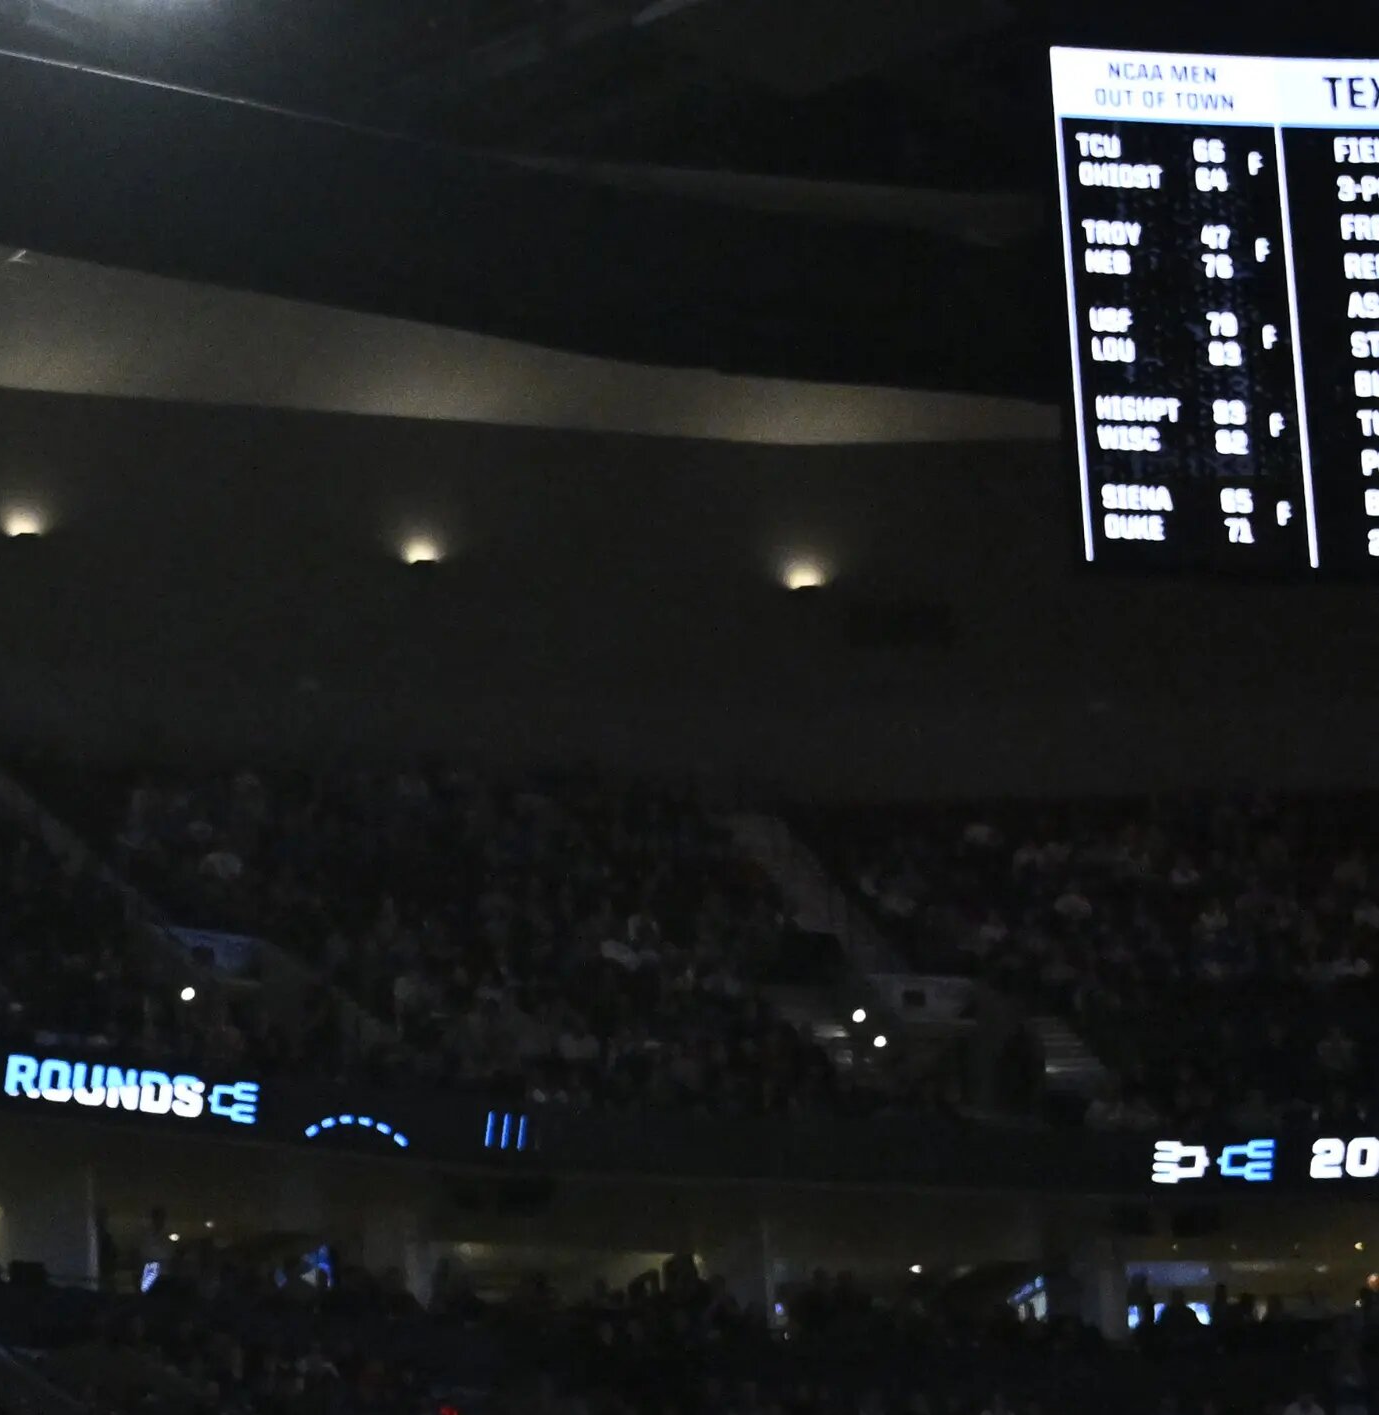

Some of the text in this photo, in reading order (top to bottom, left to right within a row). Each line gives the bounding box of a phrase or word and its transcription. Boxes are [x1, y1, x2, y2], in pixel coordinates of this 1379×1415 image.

[1108, 61, 1218, 84] NCAA MEN
[1094, 87, 1235, 113] OUT OF TOWN
[1076, 133, 1120, 158] TCU
[1334, 137, 1379, 163] FIE
[1082, 219, 1141, 246] TROY
[1092, 337, 1135, 362] LOU
[1096, 395, 1181, 422] HIGHPT
[1097, 425, 1161, 451] WISC
[1102, 484, 1173, 511] SIENA
[1105, 514, 1165, 540] DUKE
[4, 1052, 207, 1118] ROUNDS
